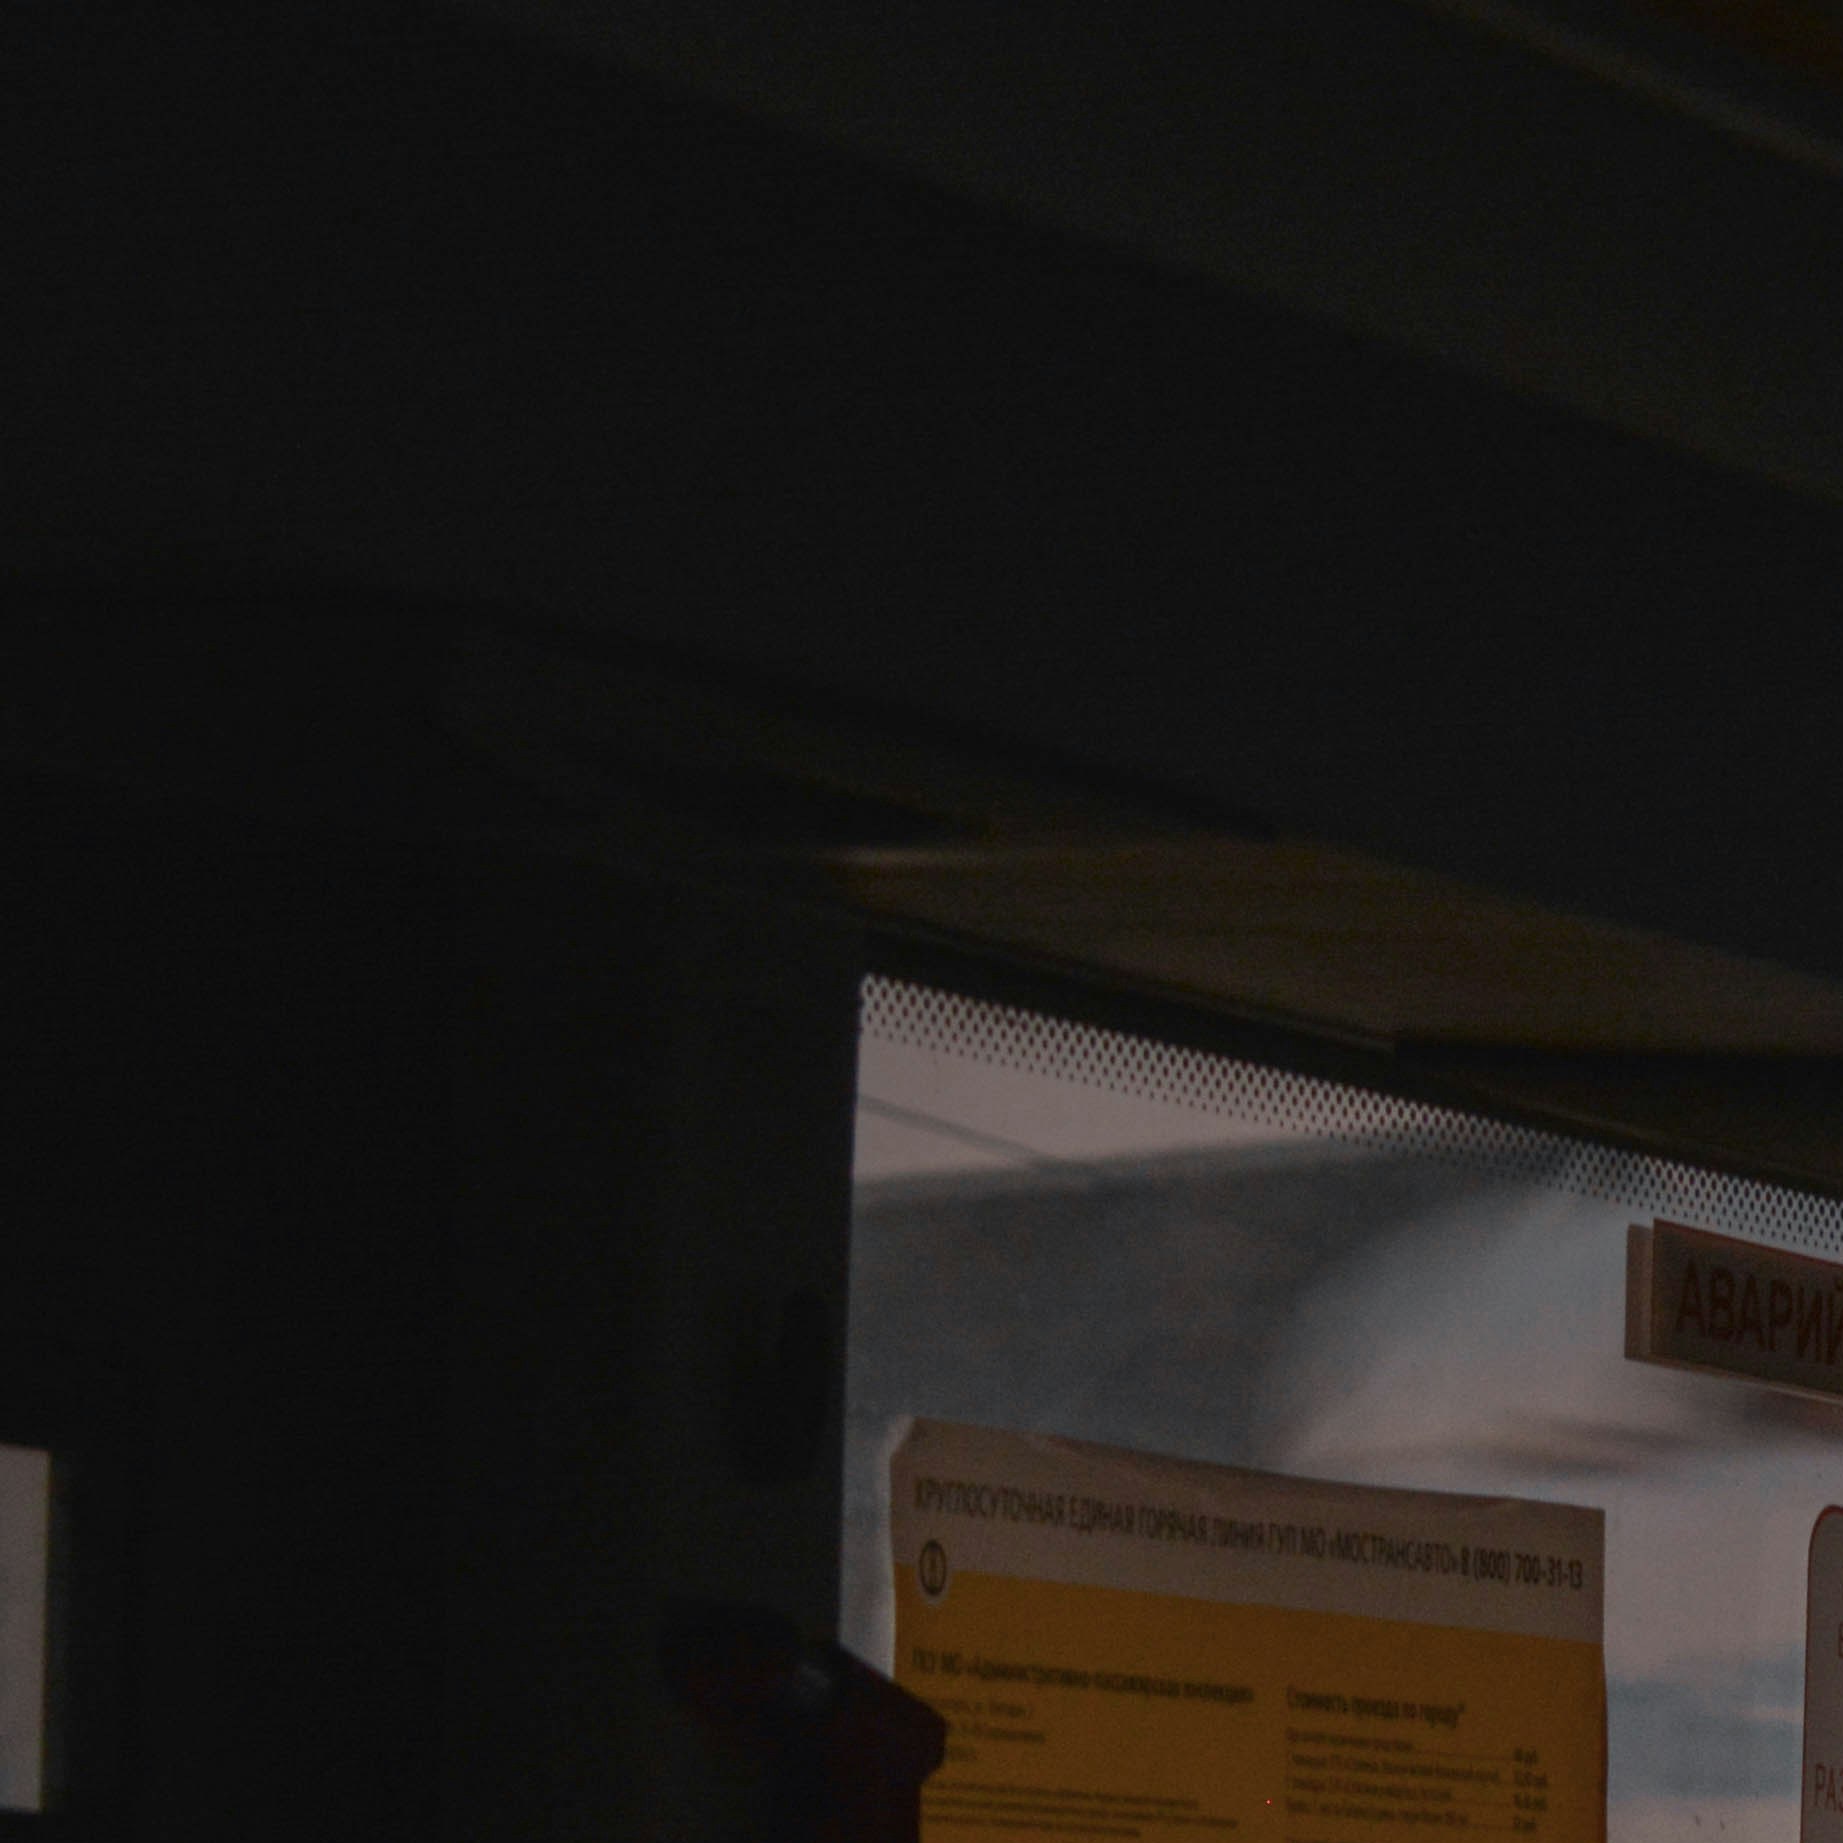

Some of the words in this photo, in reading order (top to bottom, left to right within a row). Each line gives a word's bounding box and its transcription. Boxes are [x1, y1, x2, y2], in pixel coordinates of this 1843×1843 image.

[1461, 1546, 1470, 1577] 8
[1473, 1547, 1511, 1587] (800)
[1515, 1553, 1584, 1590] 700-31-13
